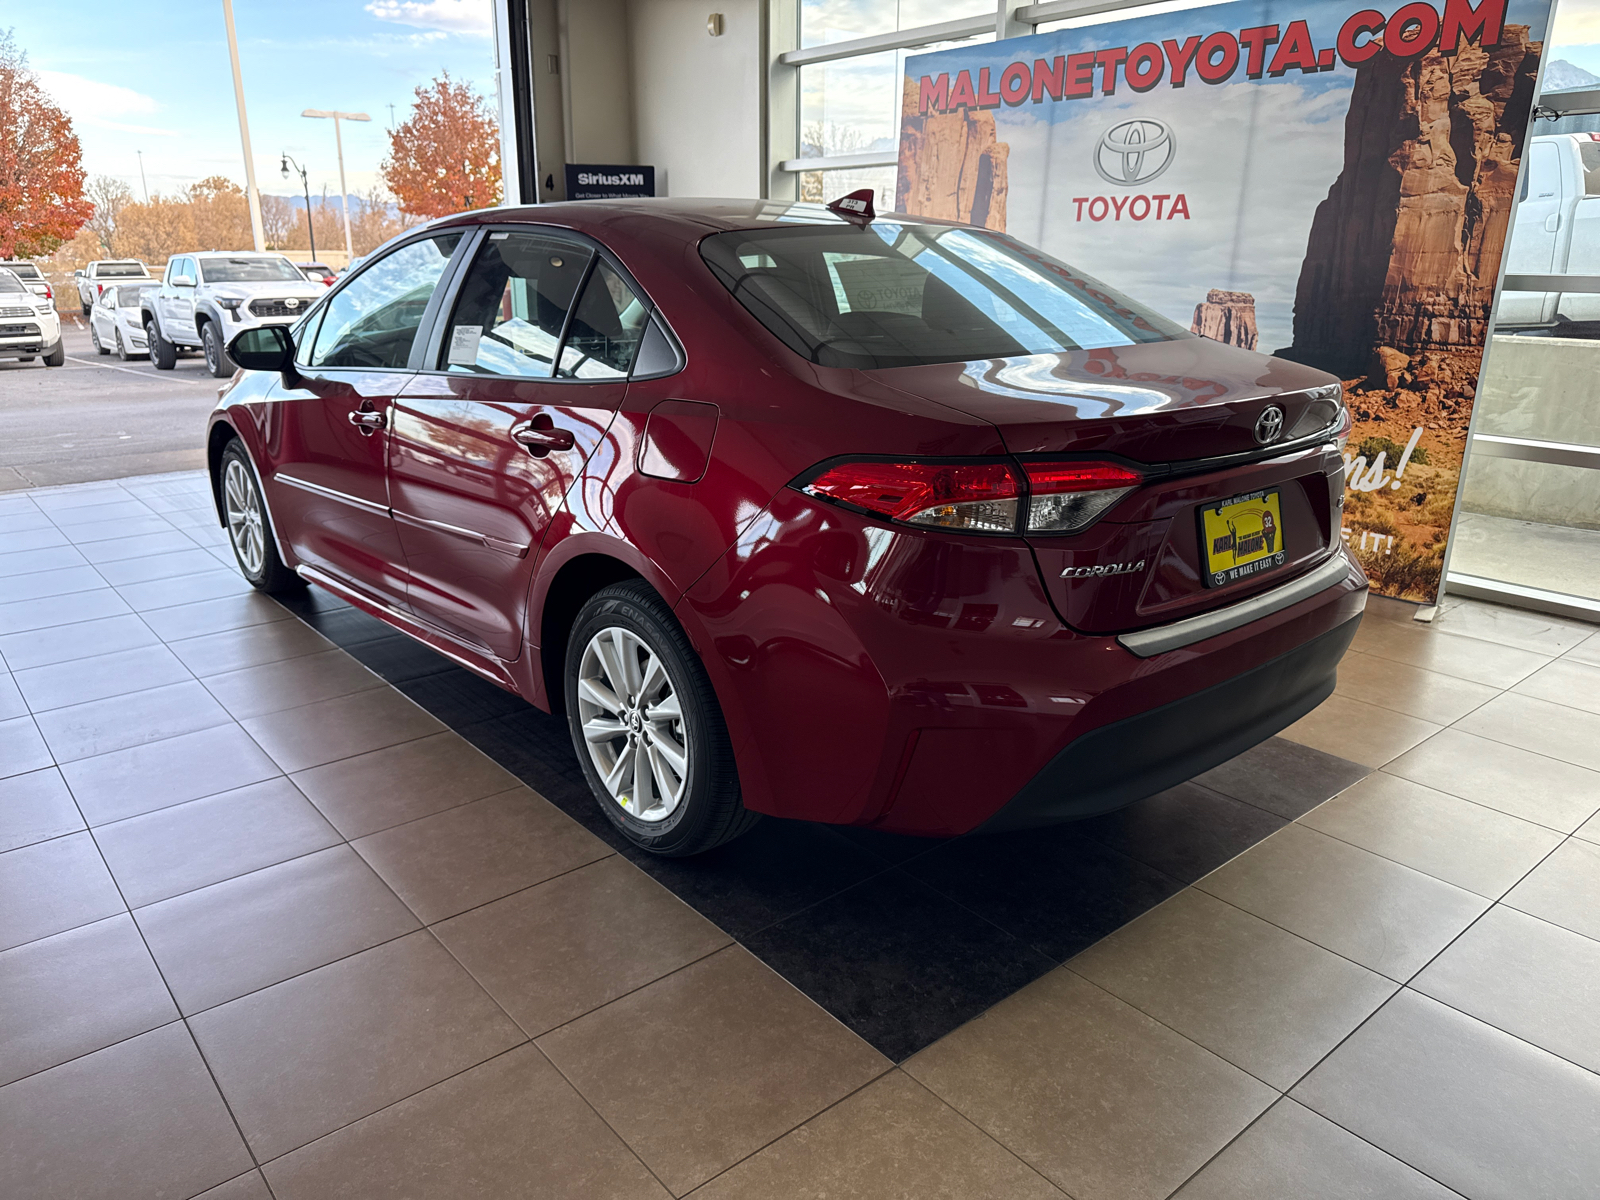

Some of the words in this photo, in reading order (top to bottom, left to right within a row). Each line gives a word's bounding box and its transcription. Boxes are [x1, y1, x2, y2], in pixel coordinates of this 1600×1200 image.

[919, 0, 1508, 116] MALONETOYOTA.COM
[545, 173, 554, 191] 4
[578, 172, 644, 186] SiriusXM
[1072, 194, 1191, 222] TOYOTA
[1221, 499, 1233, 508] KARL
[1264, 516, 1273, 528] 32
[1213, 534, 1233, 555] KARL
[1360, 531, 1394, 555] IT!
[1059, 559, 1146, 579] COROLLA
[1229, 569, 1239, 580] WE
[1239, 564, 1253, 576] MAKE
[1253, 561, 1259, 571] IT
[1260, 557, 1272, 569] EASY
